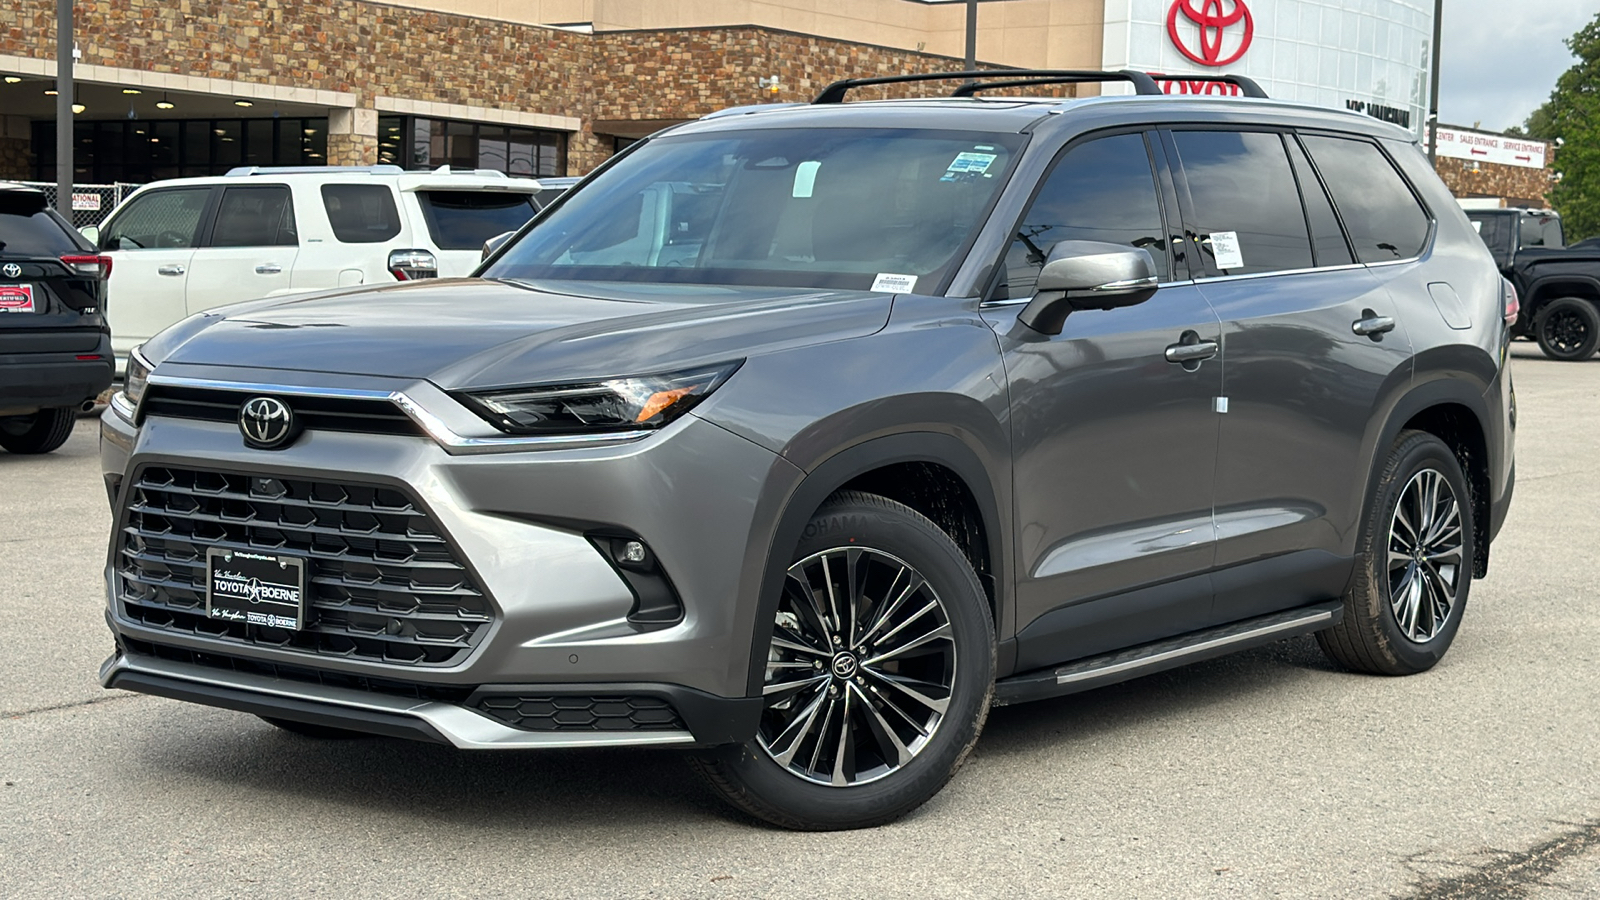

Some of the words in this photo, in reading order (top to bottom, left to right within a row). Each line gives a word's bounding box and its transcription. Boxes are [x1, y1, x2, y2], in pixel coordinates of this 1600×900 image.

[1460, 134, 1473, 145] SALES
[1474, 137, 1498, 149] ENTRANCE
[1503, 141, 1520, 151] SERVICE
[1521, 143, 1543, 154] ENTRANCE
[72, 194, 99, 202] ATIONAL
[214, 580, 250, 594] TOYOTA
[261, 586, 299, 602] BOERNE
[247, 614, 267, 623] TOYOTA
[276, 619, 297, 627] BOERNE
